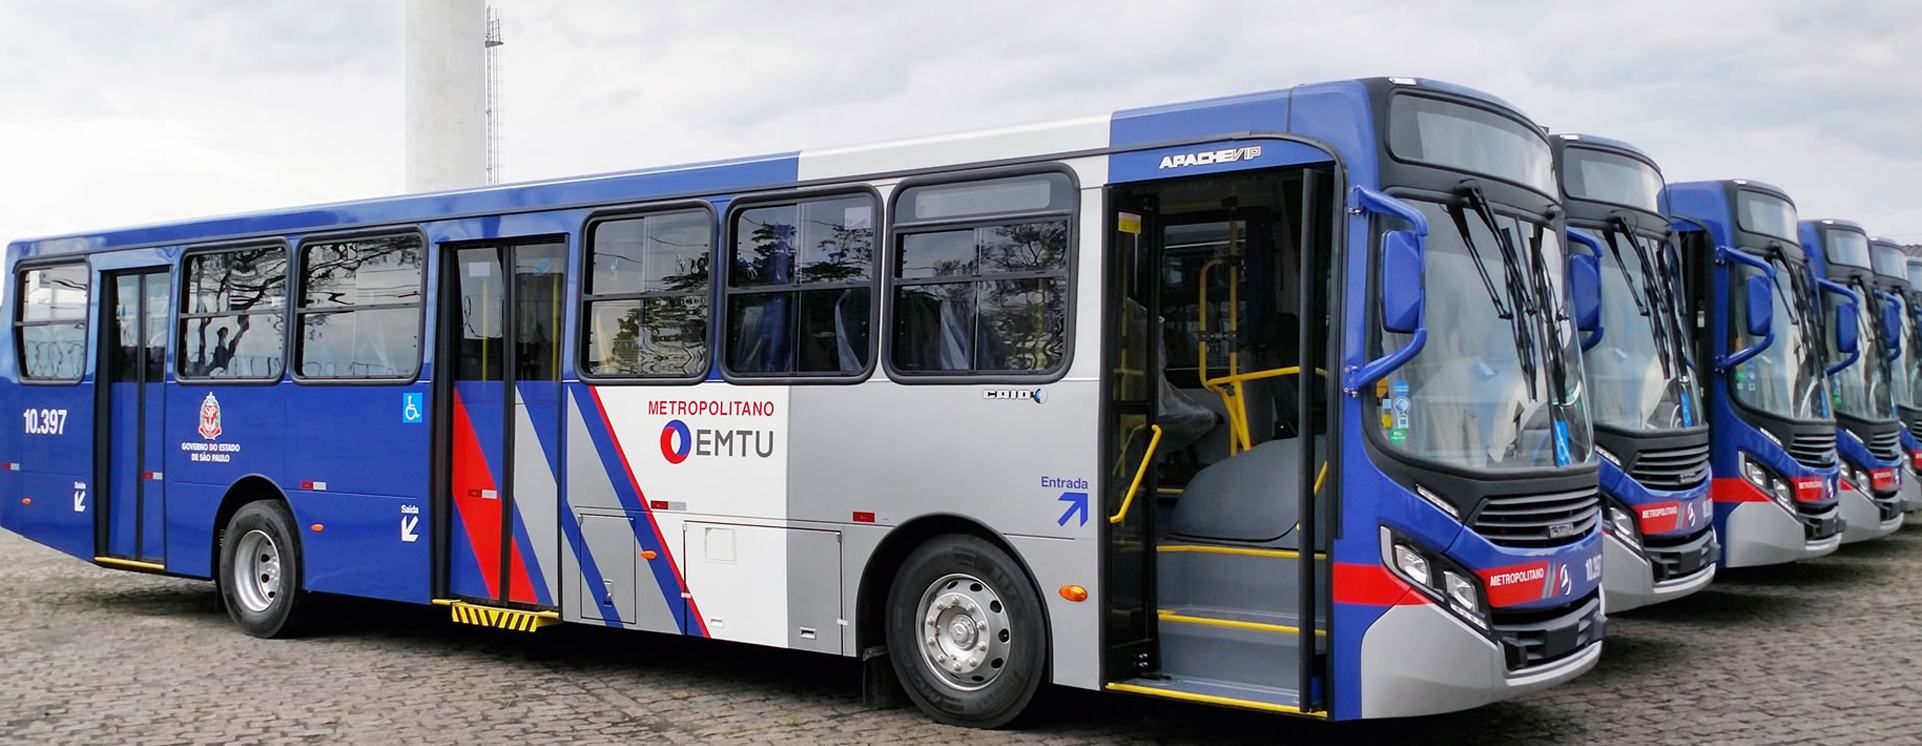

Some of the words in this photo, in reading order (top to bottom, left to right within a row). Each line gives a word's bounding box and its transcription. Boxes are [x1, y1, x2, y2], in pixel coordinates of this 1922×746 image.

[983, 390, 1032, 399] CAIO
[648, 400, 775, 416] METROPOLITANO
[23, 409, 67, 434] 10.397
[181, 442, 209, 451] GOVERNO
[209, 443, 218, 452] DO
[218, 443, 241, 452] ESTADO
[696, 429, 774, 458] EMTU
[191, 453, 199, 462] DE
[211, 454, 230, 463] PAULO
[1041, 476, 1089, 489] Entrada
[1490, 568, 1544, 586] METROPOLITANO
